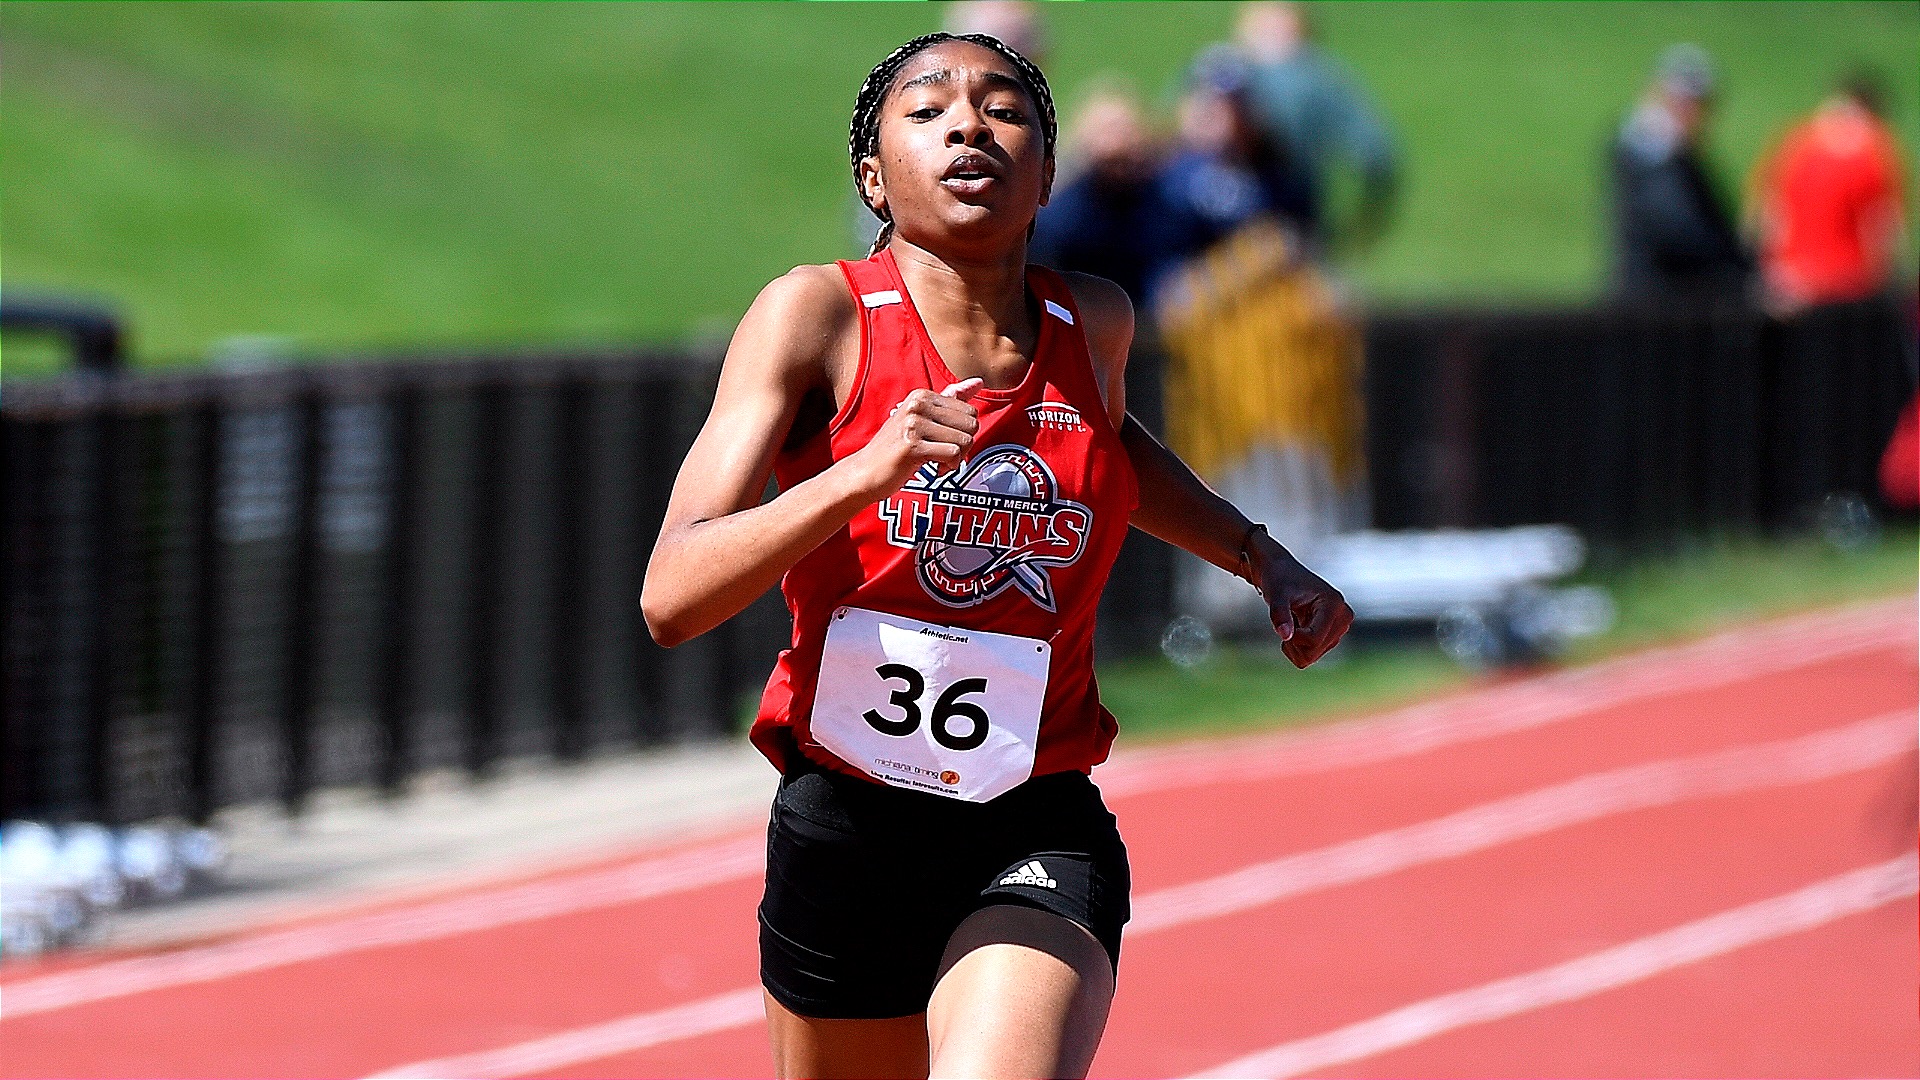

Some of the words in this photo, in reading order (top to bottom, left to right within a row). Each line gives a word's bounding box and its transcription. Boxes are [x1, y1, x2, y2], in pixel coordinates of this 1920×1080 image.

[1028, 410, 1081, 424] HORIZON
[939, 490, 1001, 508] DETROIT
[1004, 499, 1048, 512] MERCY
[879, 488, 1090, 563] TITANS
[920, 627, 969, 643] Athletic.net
[861, 663, 990, 751] 36
[1000, 872, 1056, 889] adidas
